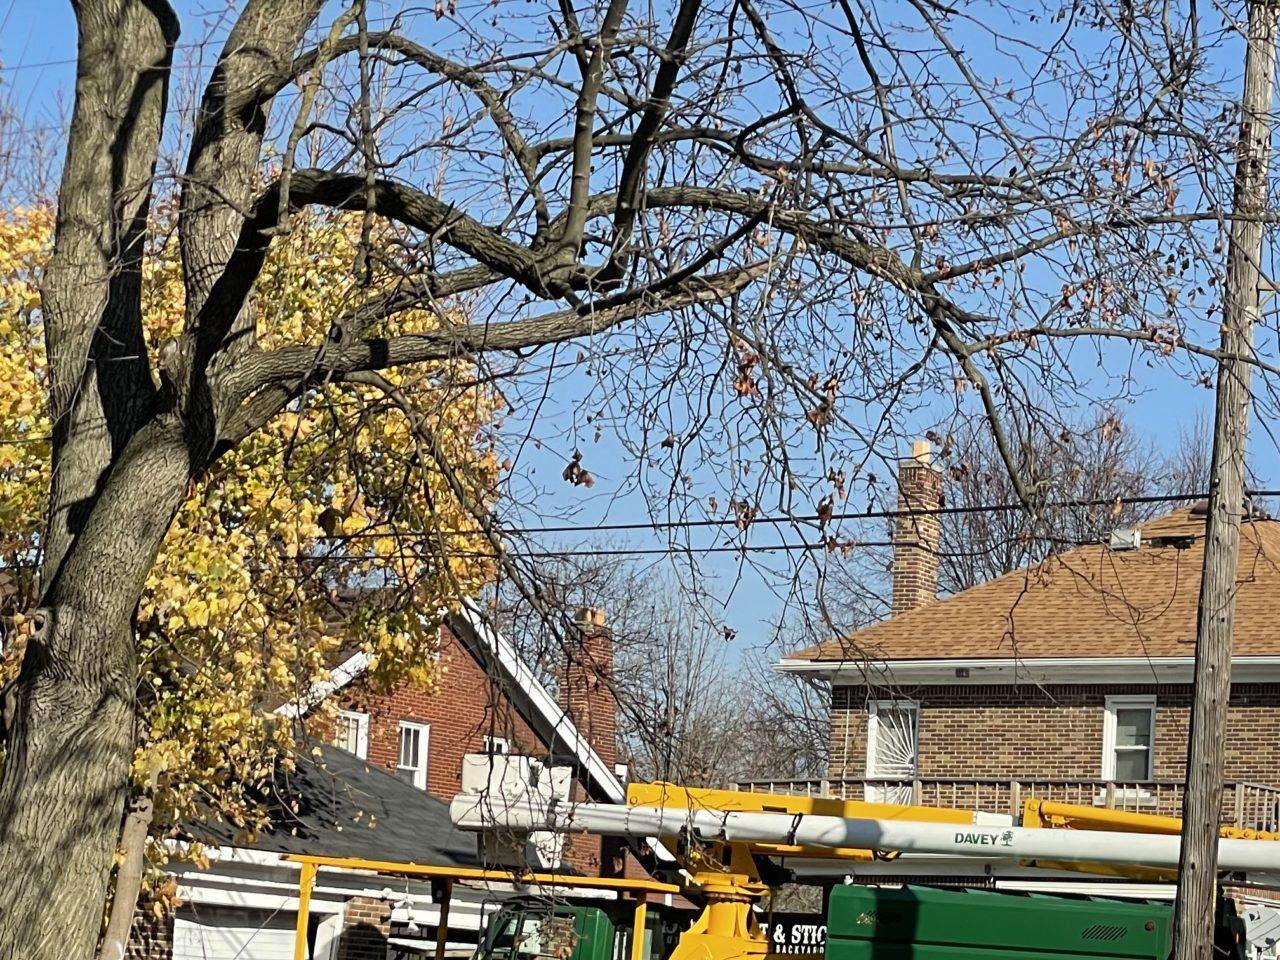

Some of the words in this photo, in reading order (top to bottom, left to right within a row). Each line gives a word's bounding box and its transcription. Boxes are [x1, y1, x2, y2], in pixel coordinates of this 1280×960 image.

[954, 832, 999, 845] DAVEY
[773, 924, 786, 944] &
[775, 944, 825, 955] BACKYARD
